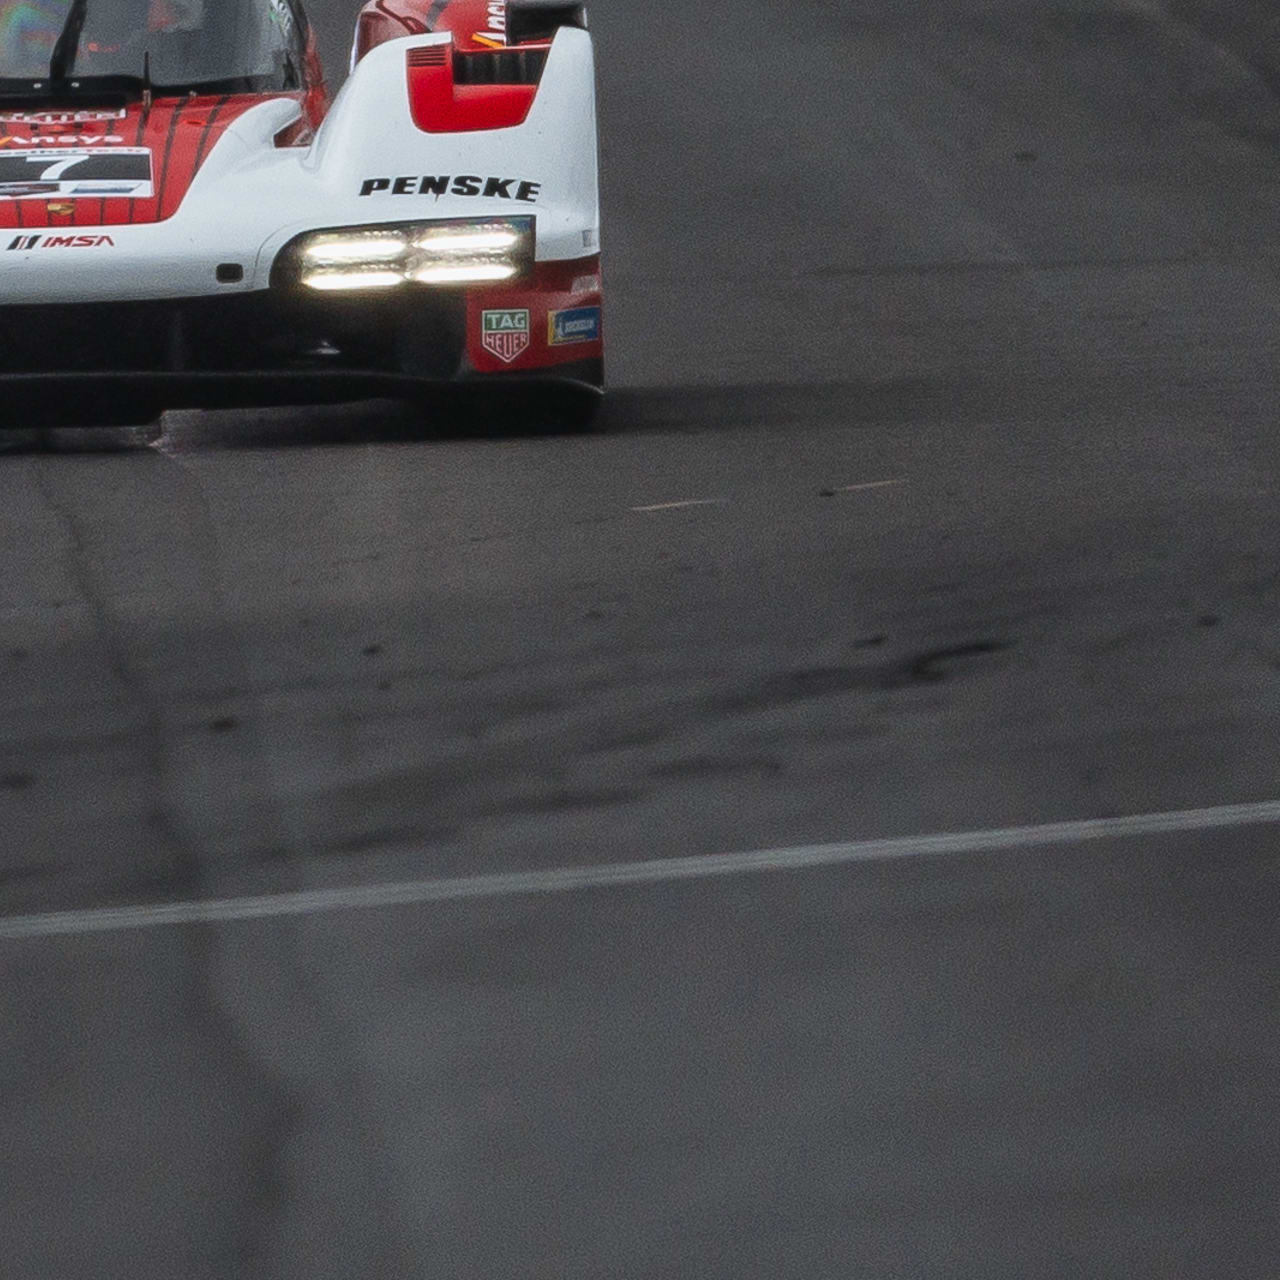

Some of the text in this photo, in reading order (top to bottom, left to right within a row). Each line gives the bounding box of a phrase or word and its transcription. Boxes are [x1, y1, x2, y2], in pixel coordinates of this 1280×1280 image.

[25, 155, 90, 180] 7
[359, 175, 542, 202] PENSKE
[41, 235, 115, 248] IMSA
[486, 313, 526, 329] TAG
[486, 332, 527, 359] HEUER
